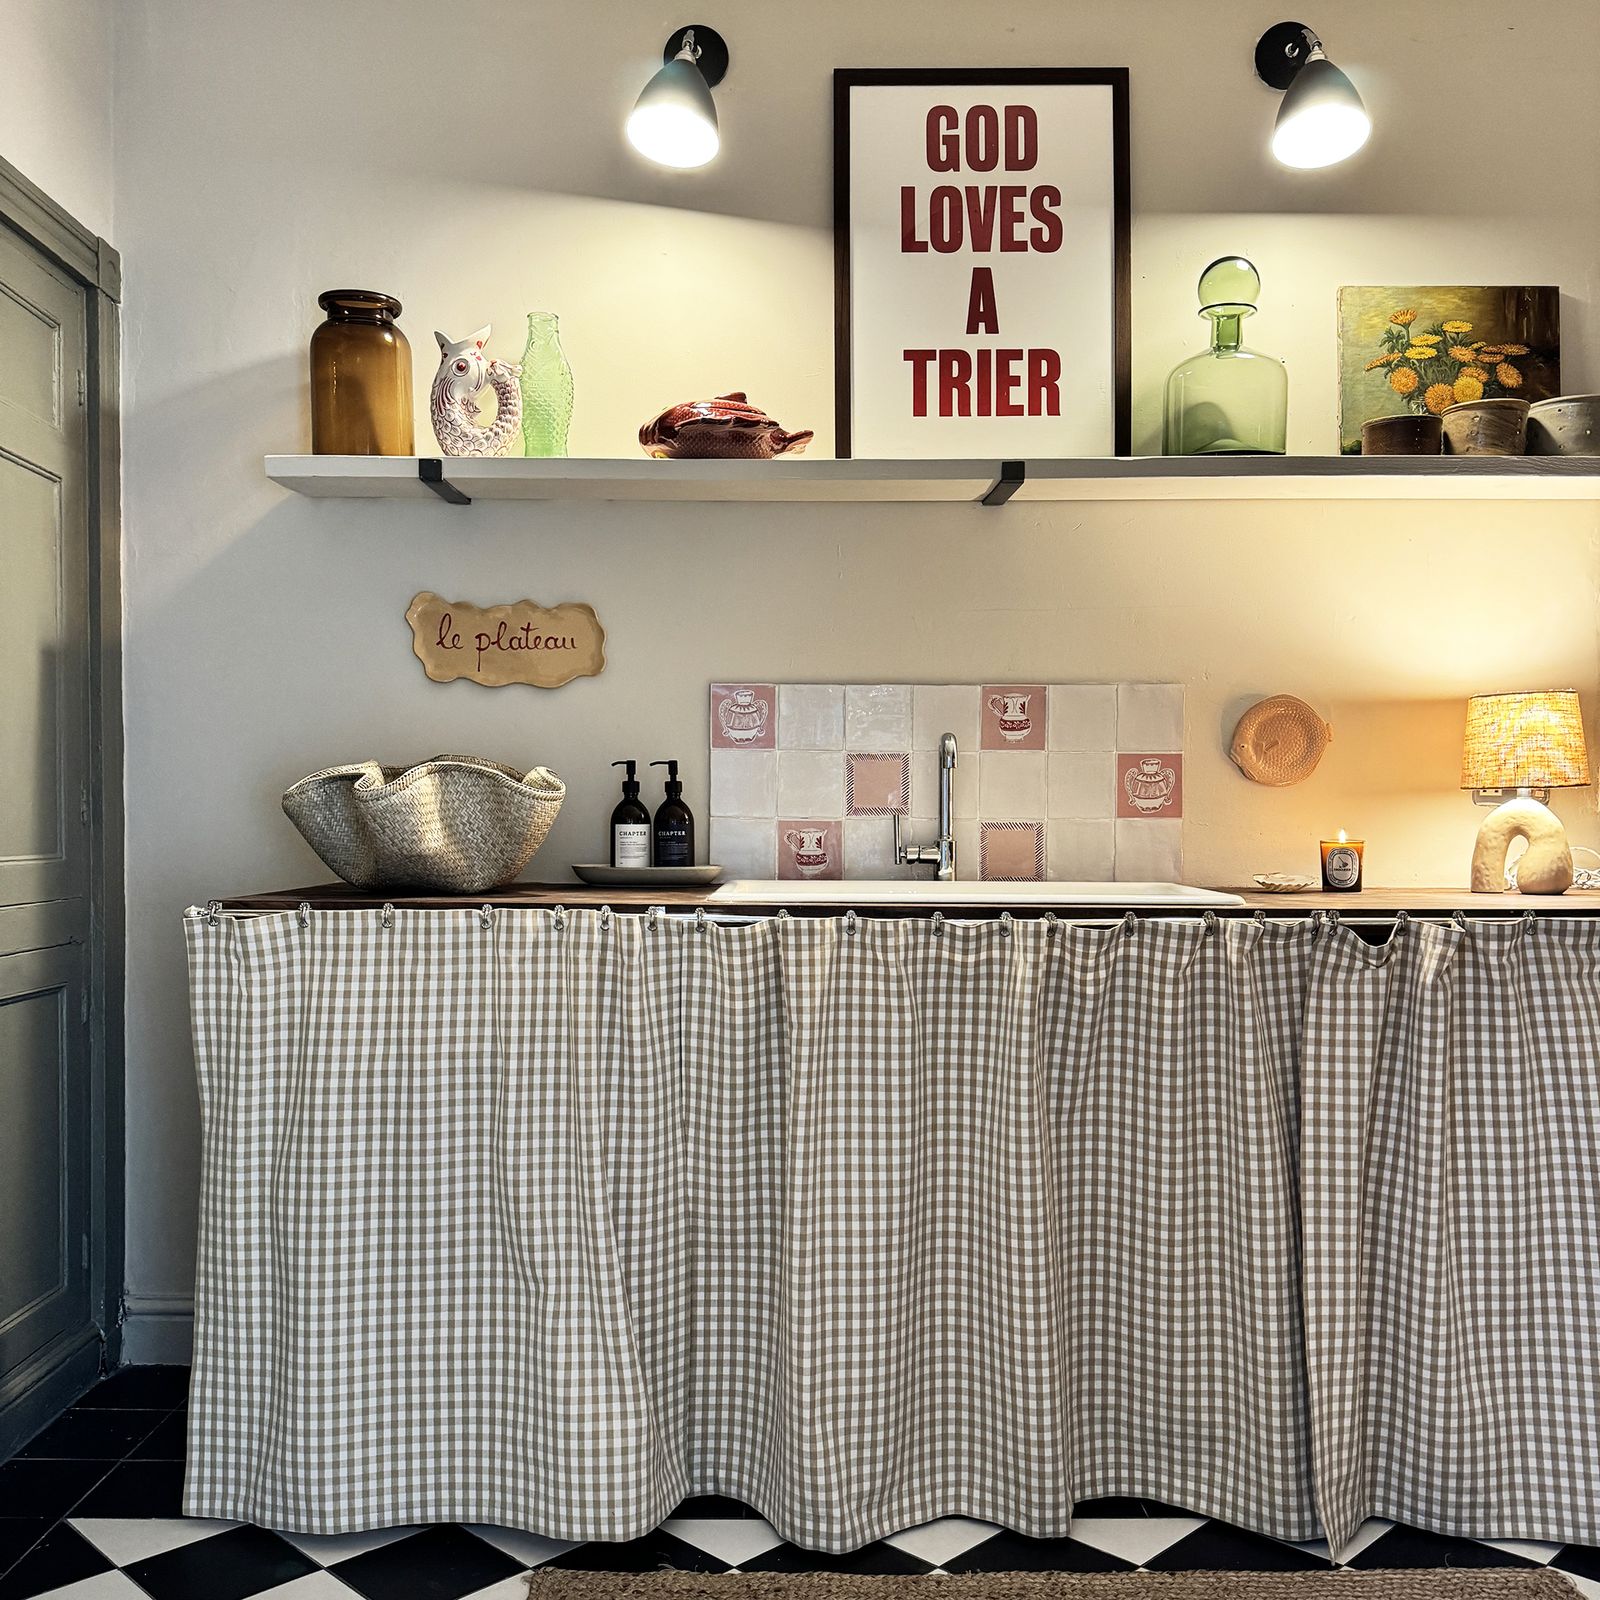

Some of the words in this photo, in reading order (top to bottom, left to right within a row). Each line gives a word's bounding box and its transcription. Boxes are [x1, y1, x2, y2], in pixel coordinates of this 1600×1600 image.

[926, 105, 1038, 172] GOD
[901, 185, 1063, 253] LOVES
[966, 267, 999, 334] A
[903, 348, 1061, 417] TRIER
[436, 613, 463, 649] le
[475, 621, 577, 672] plateau
